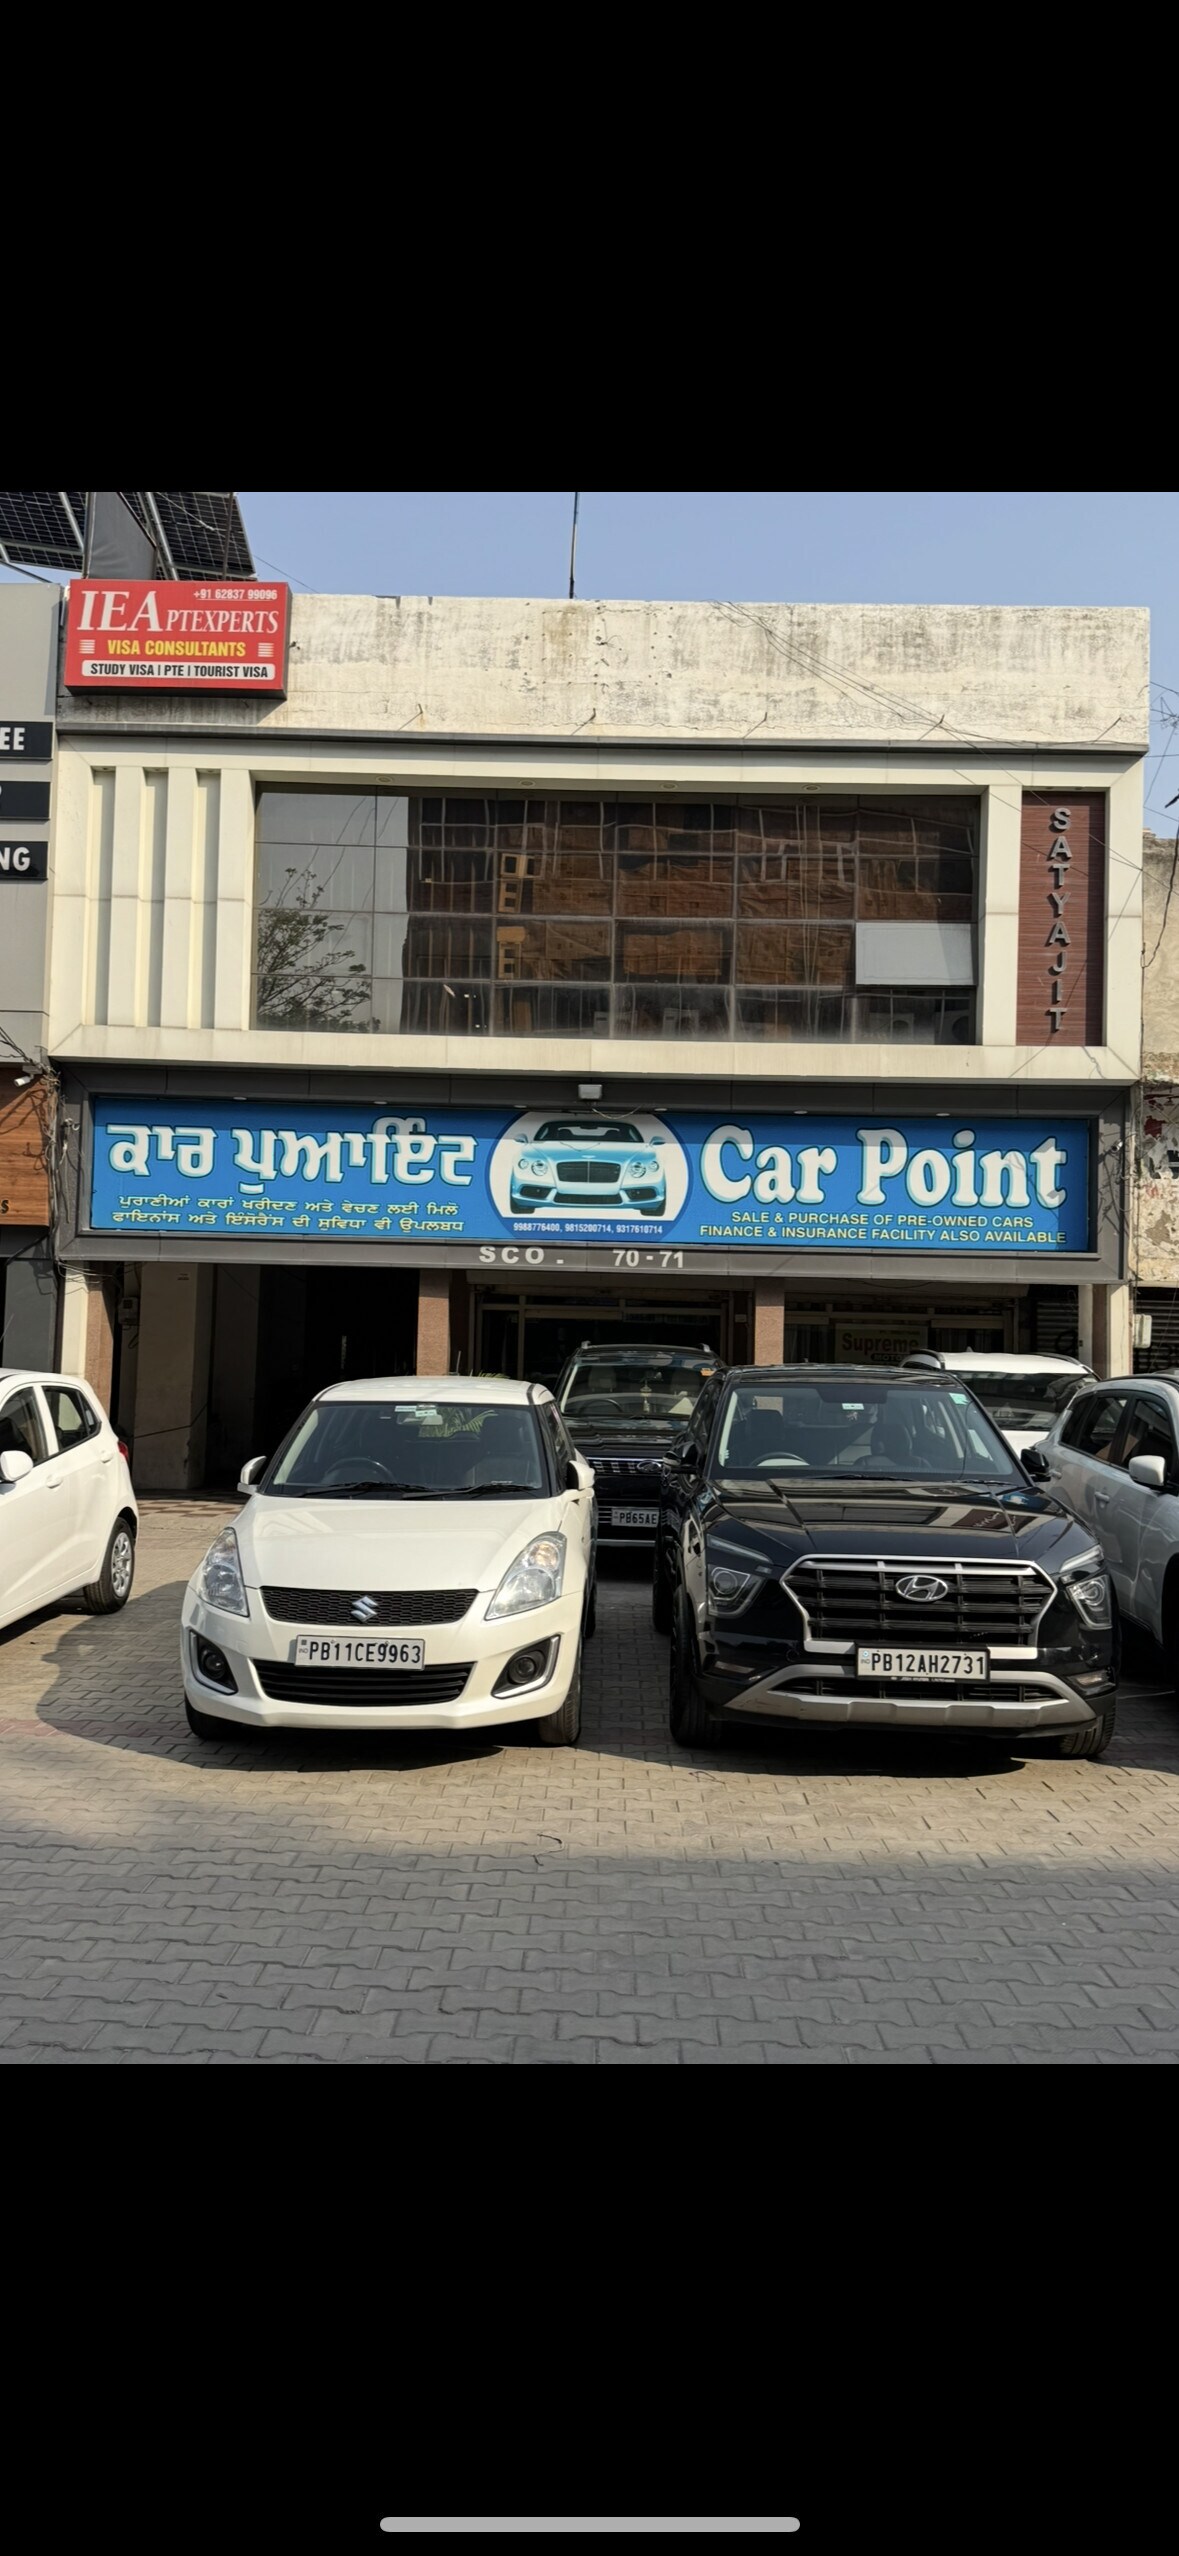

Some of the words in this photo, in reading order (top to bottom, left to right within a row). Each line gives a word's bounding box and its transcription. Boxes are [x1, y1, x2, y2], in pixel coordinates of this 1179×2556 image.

[193, 588, 211, 600] +91
[215, 588, 244, 600] 62837
[248, 589, 278, 601] 99096
[77, 590, 163, 632] IEA
[165, 609, 280, 633] PTEXPERTS
[107, 639, 141, 655] VISA
[145, 640, 246, 657] CONSULTANTS
[90, 663, 126, 675] STUDY
[129, 664, 154, 676] VISA
[164, 665, 184, 677] PTE
[194, 665, 240, 677] TOURIST
[242, 666, 268, 678] VISA
[1048, 807, 1073, 1031] SATYAJIT
[105, 1123, 219, 1178] ਕਾਰ
[230, 1116, 478, 1194] ਪੁਆਇੰਟ
[700, 1125, 838, 1204] Car
[856, 1128, 1068, 1208] Point
[119, 1193, 191, 1209] ਪੁਰਾਣੀਆਂ
[198, 1197, 234, 1209] ਕਾਰਾਂ
[305, 1199, 335, 1212] ਅਤੇ
[387, 1201, 419, 1215] ਲਈ
[188, 1212, 218, 1225] ਅਤੇ
[292, 1214, 311, 1228] ਦੀ
[374, 1217, 392, 1230] ਵੀ
[732, 1211, 770, 1223] SALE
[774, 1212, 784, 1224] &
[789, 1212, 869, 1225] PURCHASE
[873, 1214, 893, 1225] OF
[897, 1215, 988, 1227] PRE-OWNED
[992, 1216, 1033, 1228] CARS
[700, 1225, 763, 1238] FINANCE
[767, 1227, 777, 1238] &
[782, 1227, 867, 1239] INSURANCE
[872, 1228, 936, 1240] FACILITY
[940, 1230, 980, 1242] ALSO
[984, 1231, 1066, 1243] AVAILABLE
[842, 1332, 919, 1355] Supreme
[309, 1641, 421, 1664] PB11CE9963
[871, 1652, 984, 1675] PB12AH2731
